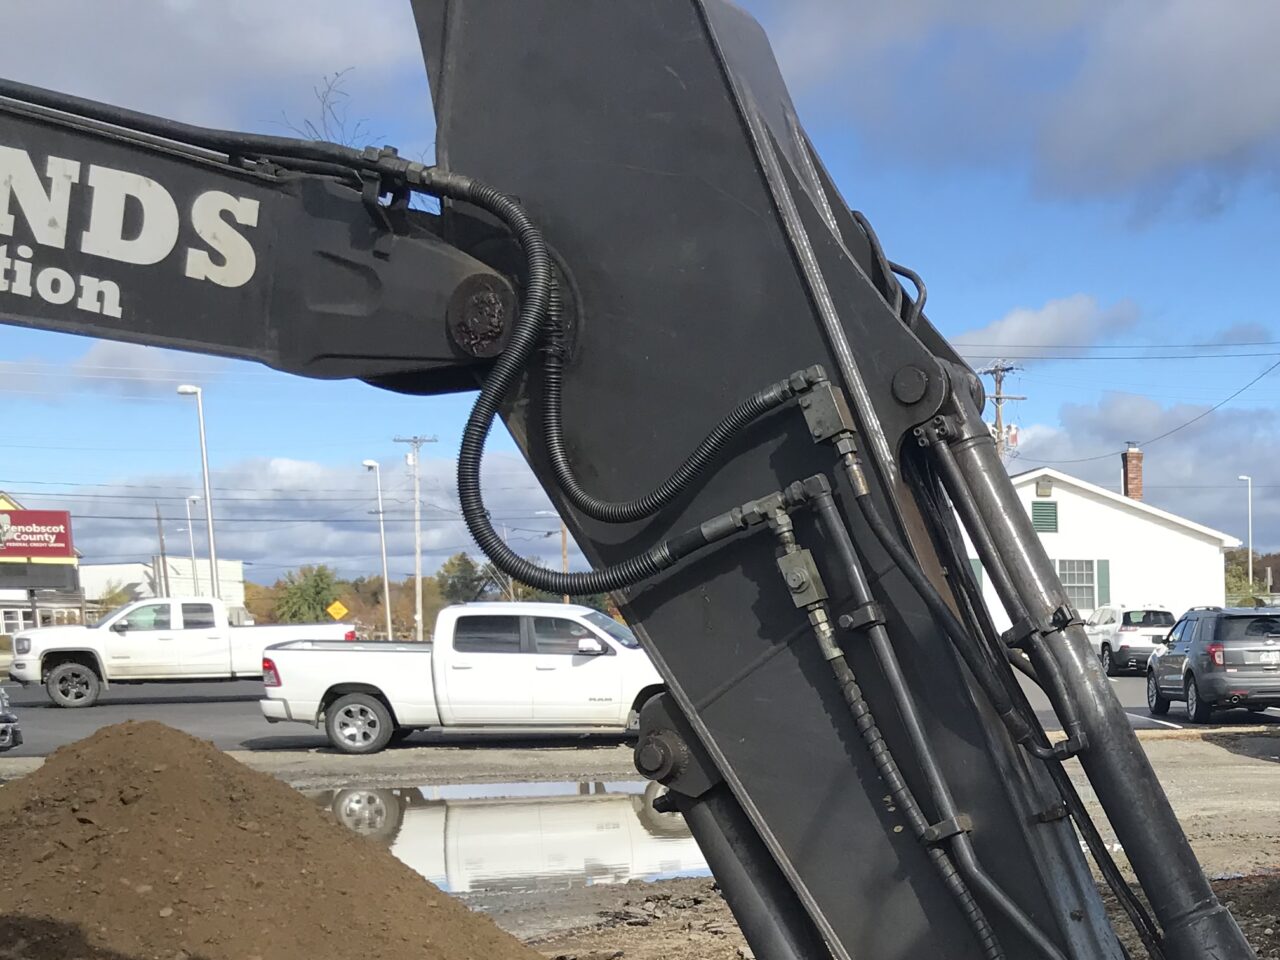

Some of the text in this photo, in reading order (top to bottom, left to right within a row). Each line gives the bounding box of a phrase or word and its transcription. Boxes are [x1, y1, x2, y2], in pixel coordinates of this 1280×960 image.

[0, 145, 260, 288] NDS
[4, 523, 65, 533] Penobscot
[14, 532, 56, 543] County
